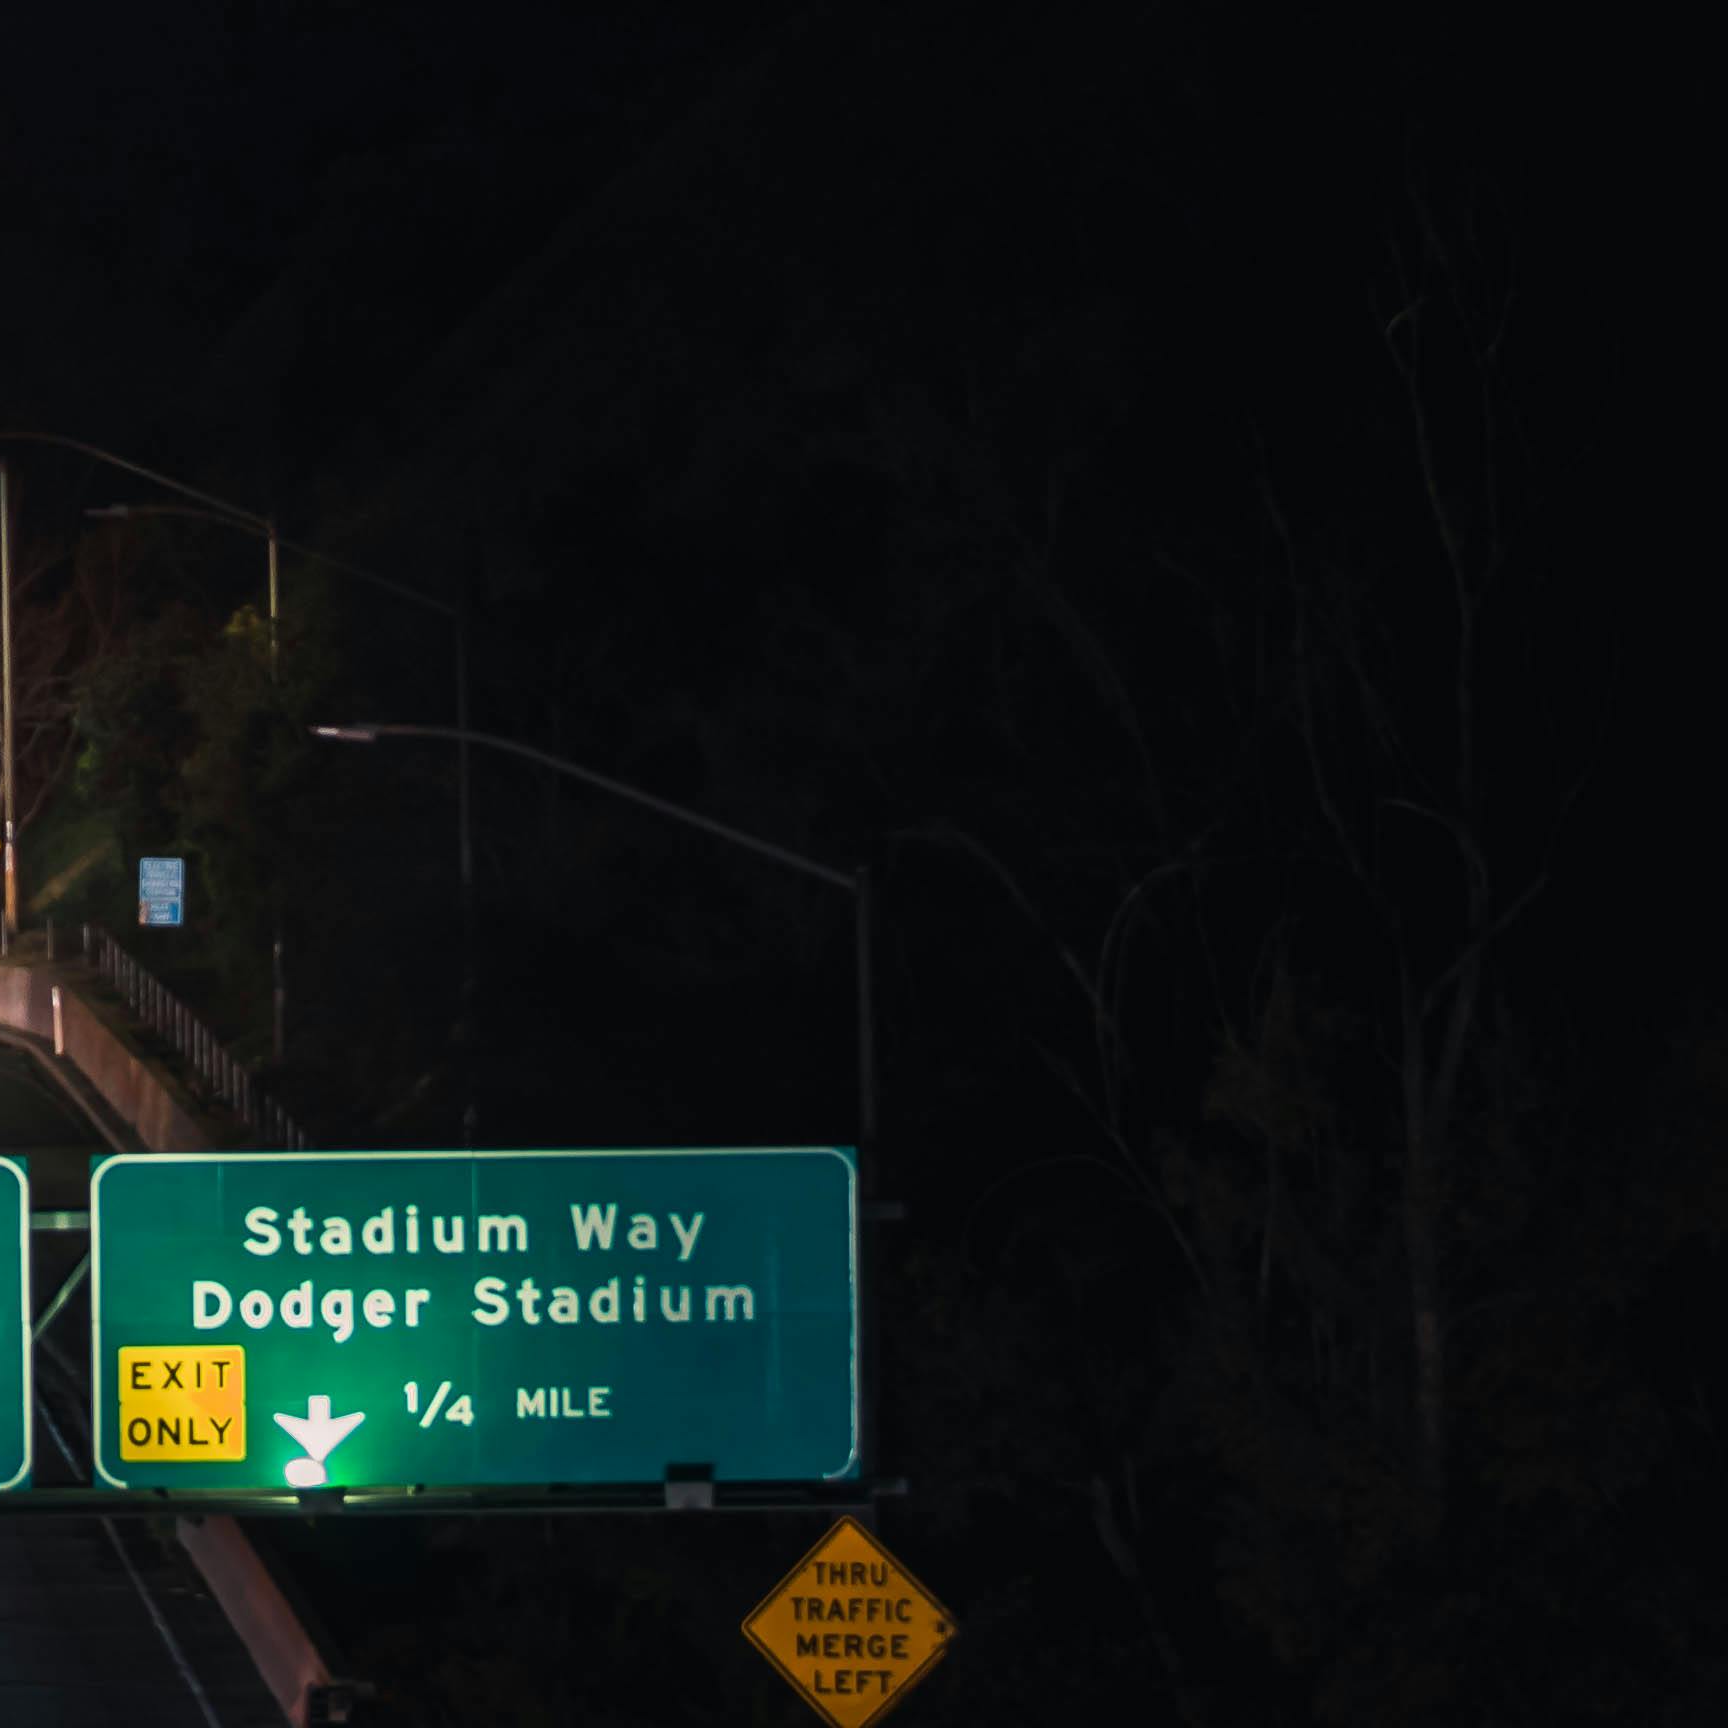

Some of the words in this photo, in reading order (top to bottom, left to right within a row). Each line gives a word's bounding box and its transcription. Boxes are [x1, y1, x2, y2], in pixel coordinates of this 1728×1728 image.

[243, 1205, 527, 1256] Stadium
[570, 1203, 704, 1260] Way
[193, 1280, 430, 1342] Dodger
[473, 1277, 755, 1325] Stadium
[130, 1360, 231, 1391] EXIT
[517, 1387, 612, 1418] MILE
[127, 1417, 233, 1448] ONLY
[813, 1561, 890, 1587] THRU
[790, 1596, 913, 1624] TRAFFIC
[796, 1633, 910, 1660] MERGE
[813, 1669, 893, 1695] LEFT
